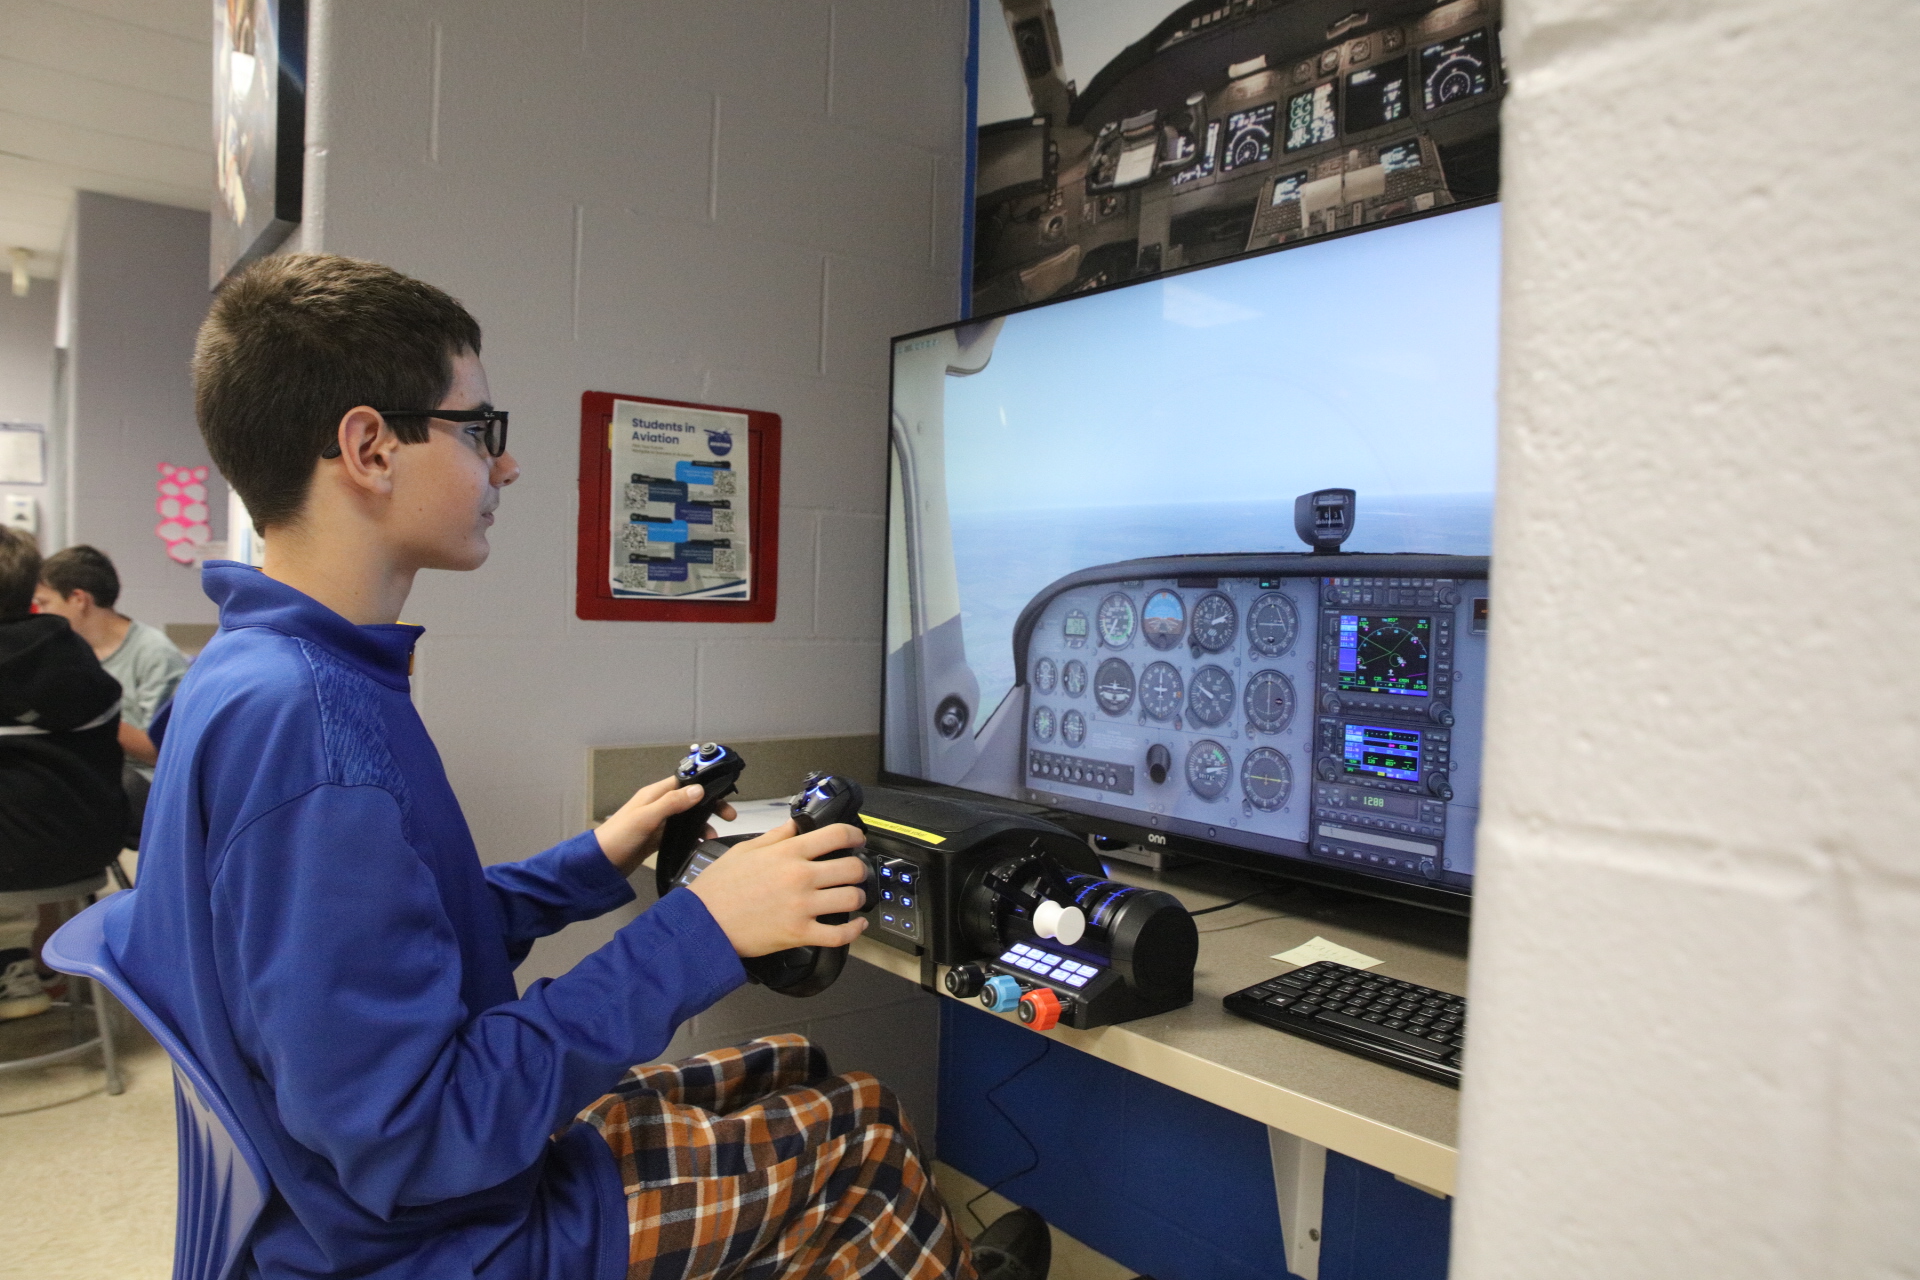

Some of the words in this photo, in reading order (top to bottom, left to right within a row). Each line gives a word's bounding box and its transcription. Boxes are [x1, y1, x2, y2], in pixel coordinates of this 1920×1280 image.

[632, 418, 683, 432] Students
[685, 422, 695, 433] in
[632, 431, 679, 444] Aviation
[1148, 833, 1166, 845] onn
